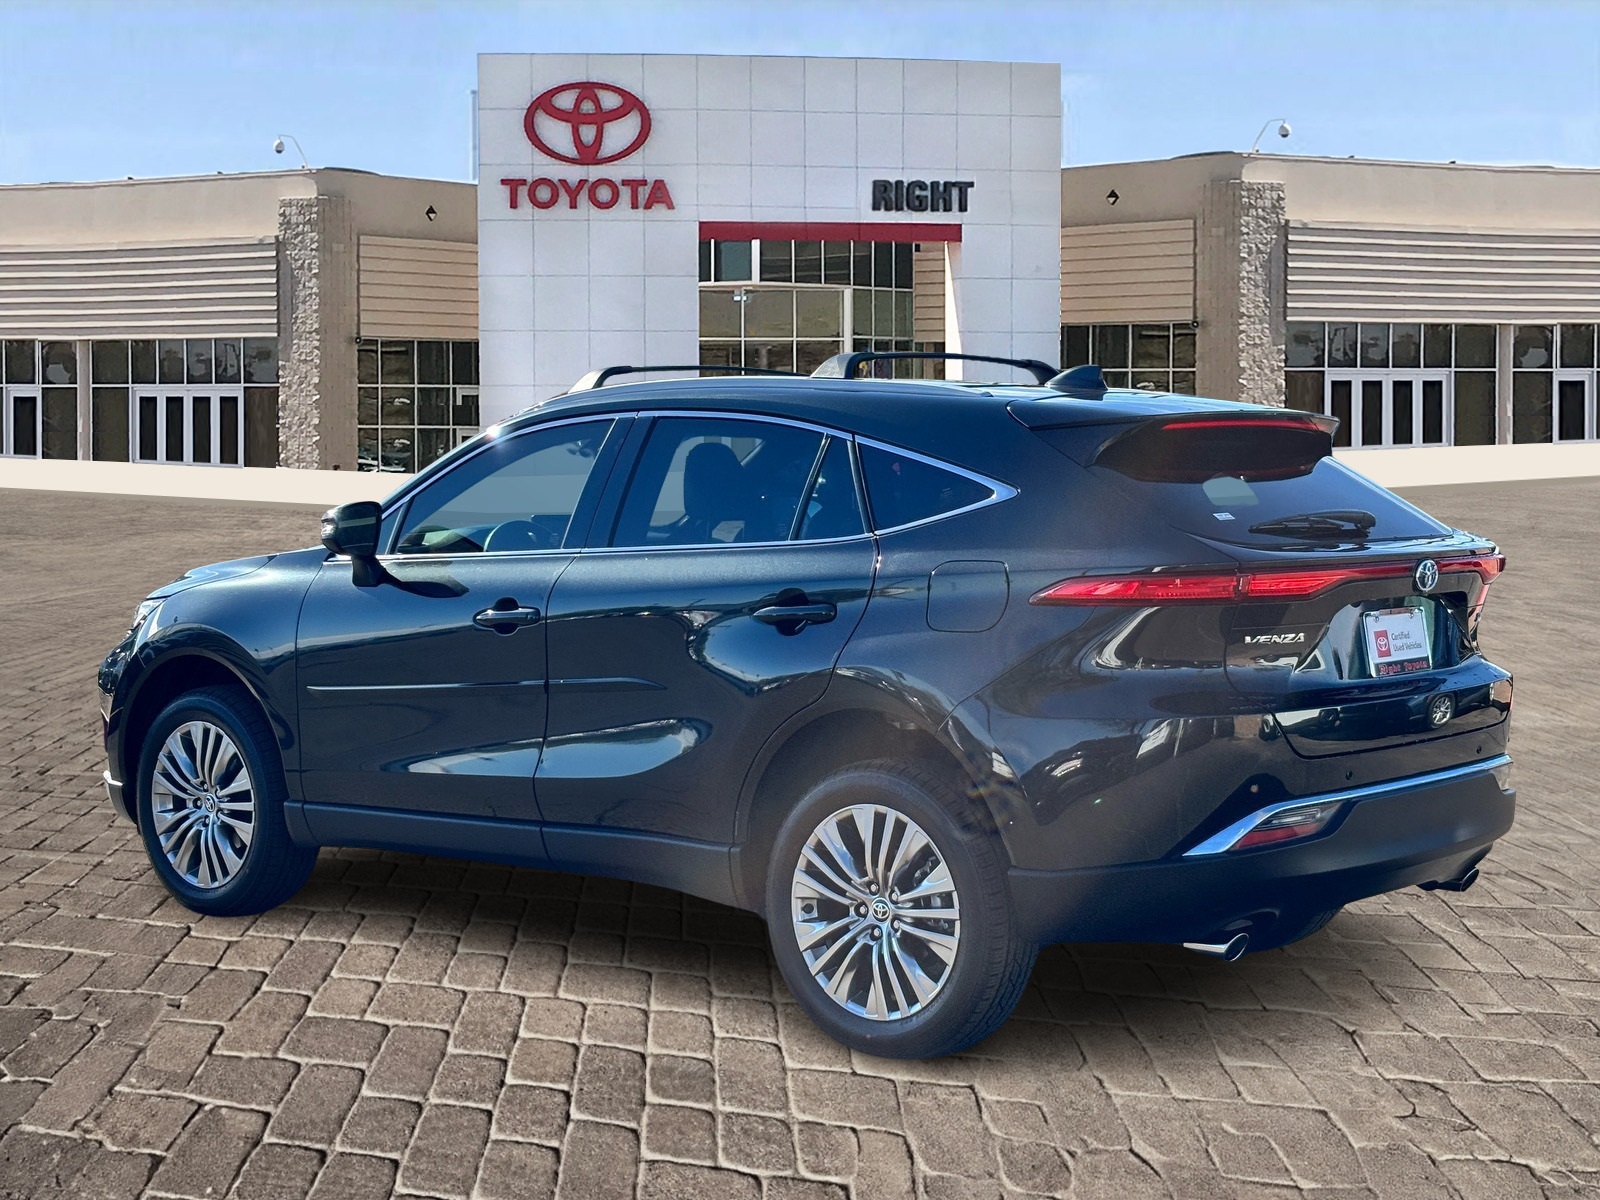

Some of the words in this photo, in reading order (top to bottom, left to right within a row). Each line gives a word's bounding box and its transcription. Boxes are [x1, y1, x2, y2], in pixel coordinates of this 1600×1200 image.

[500, 178, 675, 210] TOYOTA
[872, 180, 974, 212] RIGHT
[1244, 632, 1305, 644] VENZA
[1391, 631, 1410, 641] Certified
[1393, 643, 1404, 651] Used
[1404, 641, 1422, 651] Vehicles
[1379, 664, 1401, 674] Right
[1404, 661, 1427, 671] Toyota
